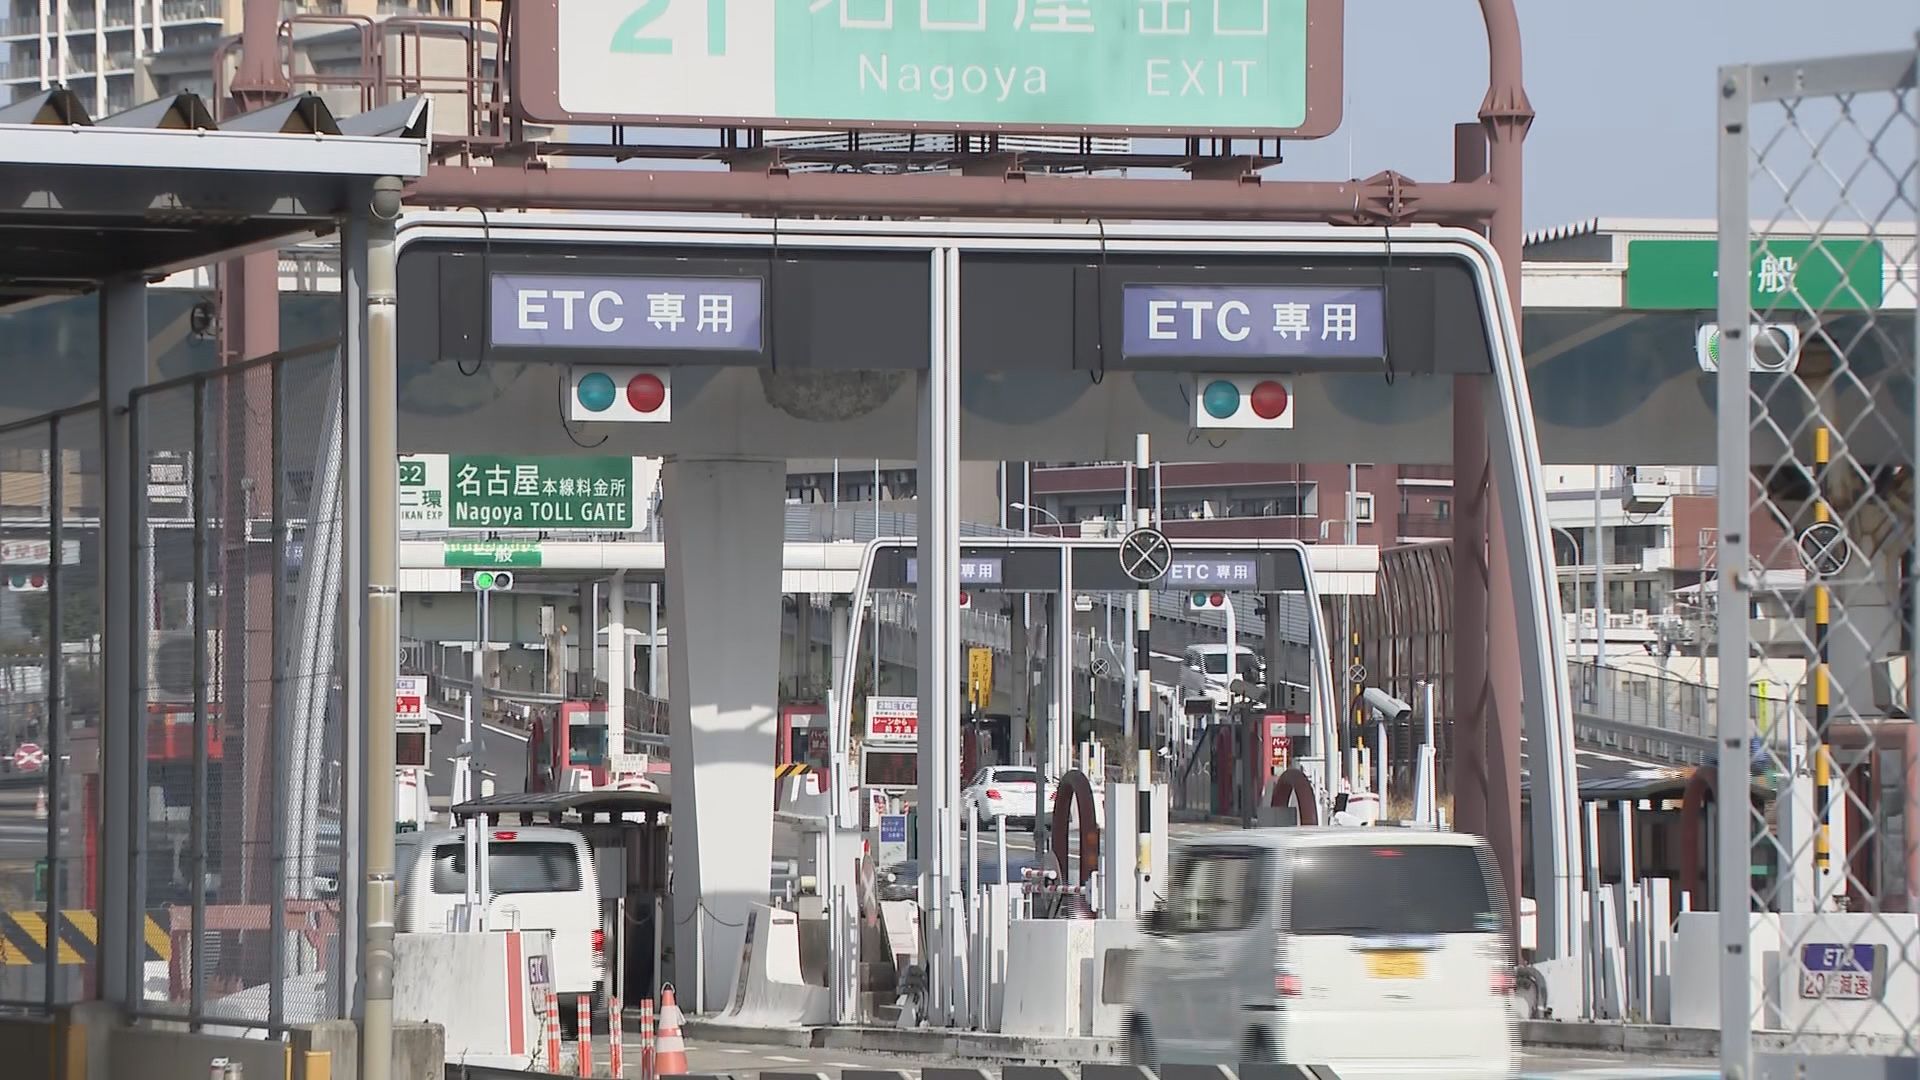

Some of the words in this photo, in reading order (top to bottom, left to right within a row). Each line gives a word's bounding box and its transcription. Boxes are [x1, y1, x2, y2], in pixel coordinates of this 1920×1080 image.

[859, 53, 1046, 102] Nagoya
[1147, 59, 1257, 97] EXIT
[518, 289, 624, 333] ETC
[646, 292, 733, 333] 専用
[1149, 300, 1251, 342] ETC
[1272, 302, 1356, 341] 専用
[427, 511, 443, 520] EXP
[456, 502, 523, 525] Nagoya
[530, 502, 573, 521] TOLL
[581, 502, 626, 521] GATE
[1171, 564, 1209, 579] ETC
[1216, 564, 1248, 579] 専用
